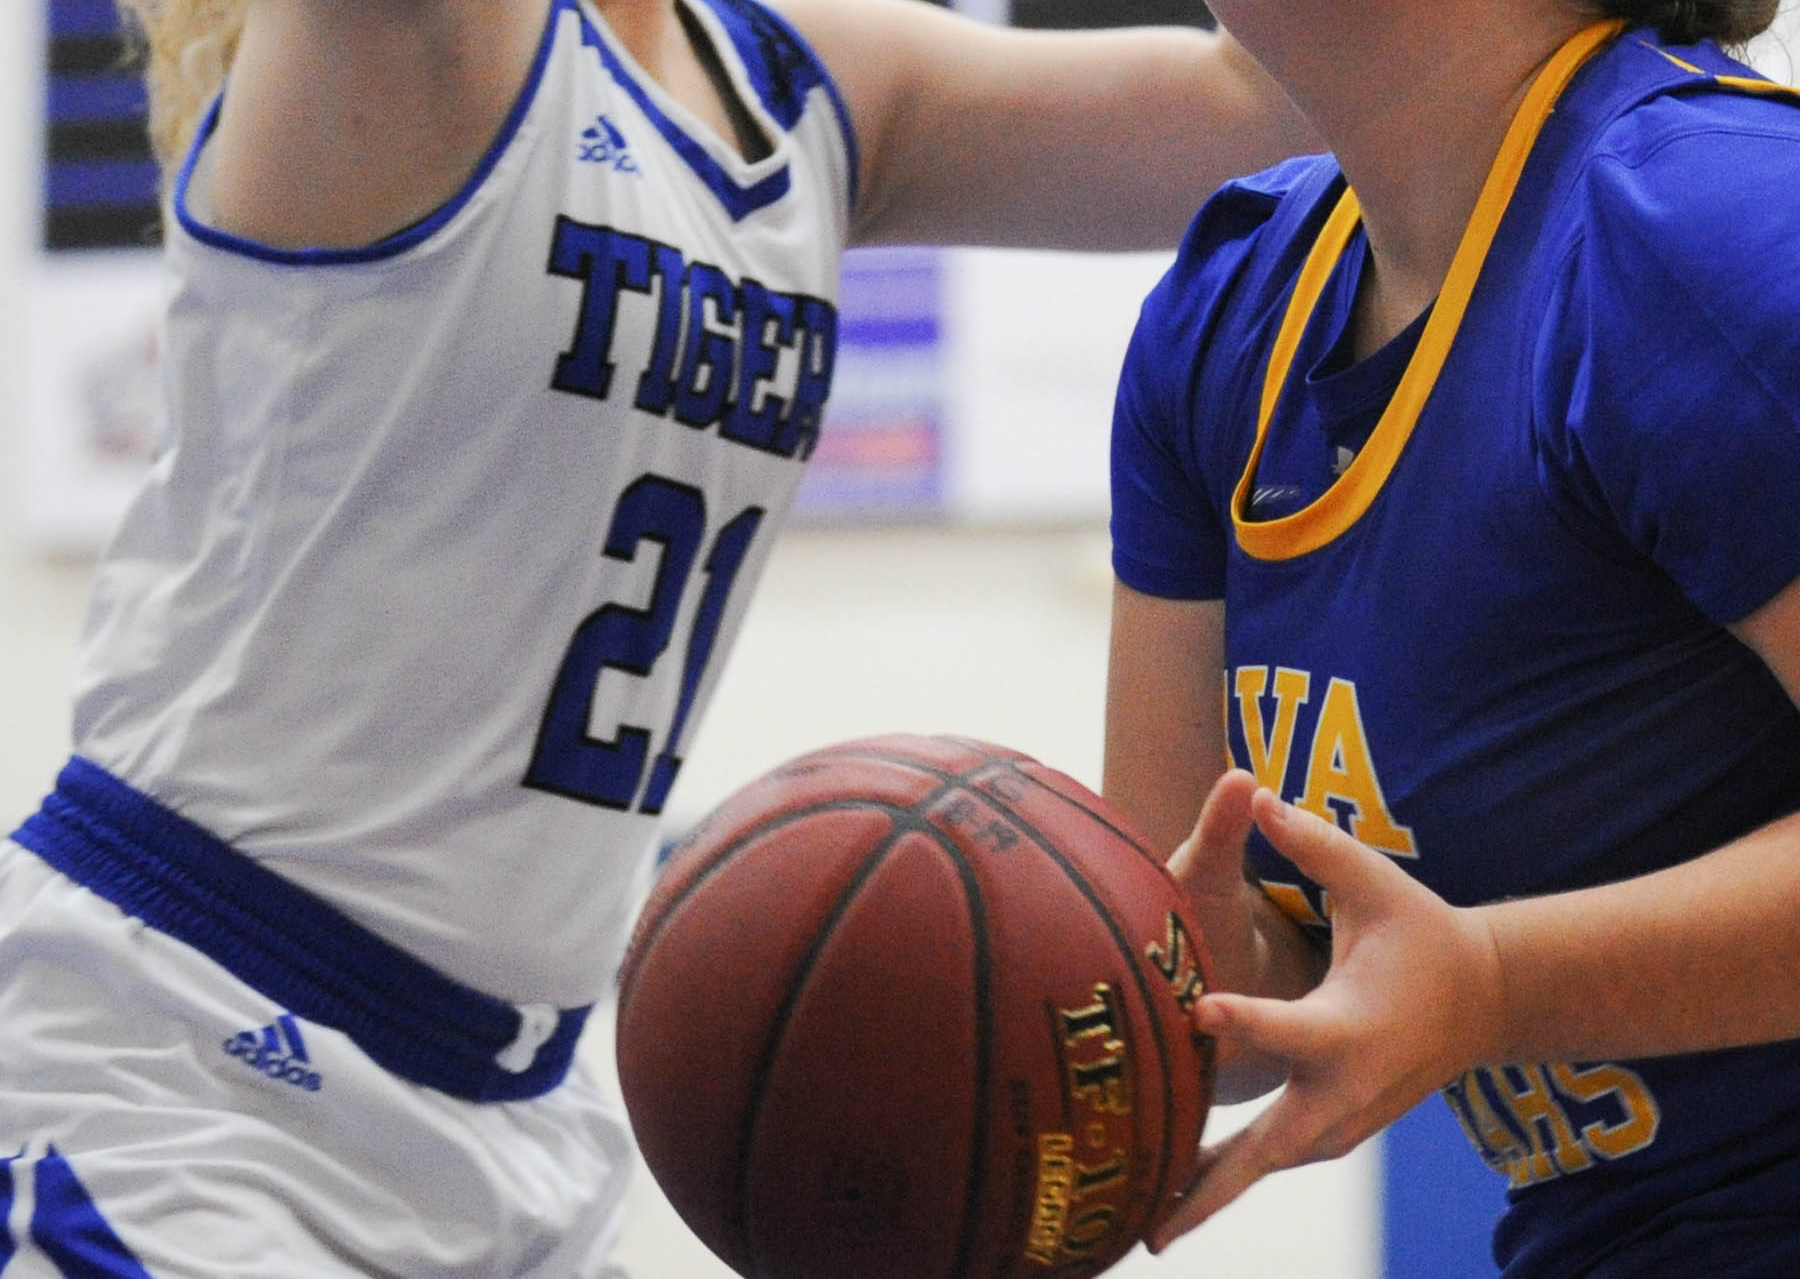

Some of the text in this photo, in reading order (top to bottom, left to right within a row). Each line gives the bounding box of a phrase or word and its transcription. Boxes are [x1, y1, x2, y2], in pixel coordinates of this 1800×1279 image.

[520, 472, 767, 816] 21
[1223, 665, 1420, 860] VA
[223, 1037, 323, 1092] adidas
